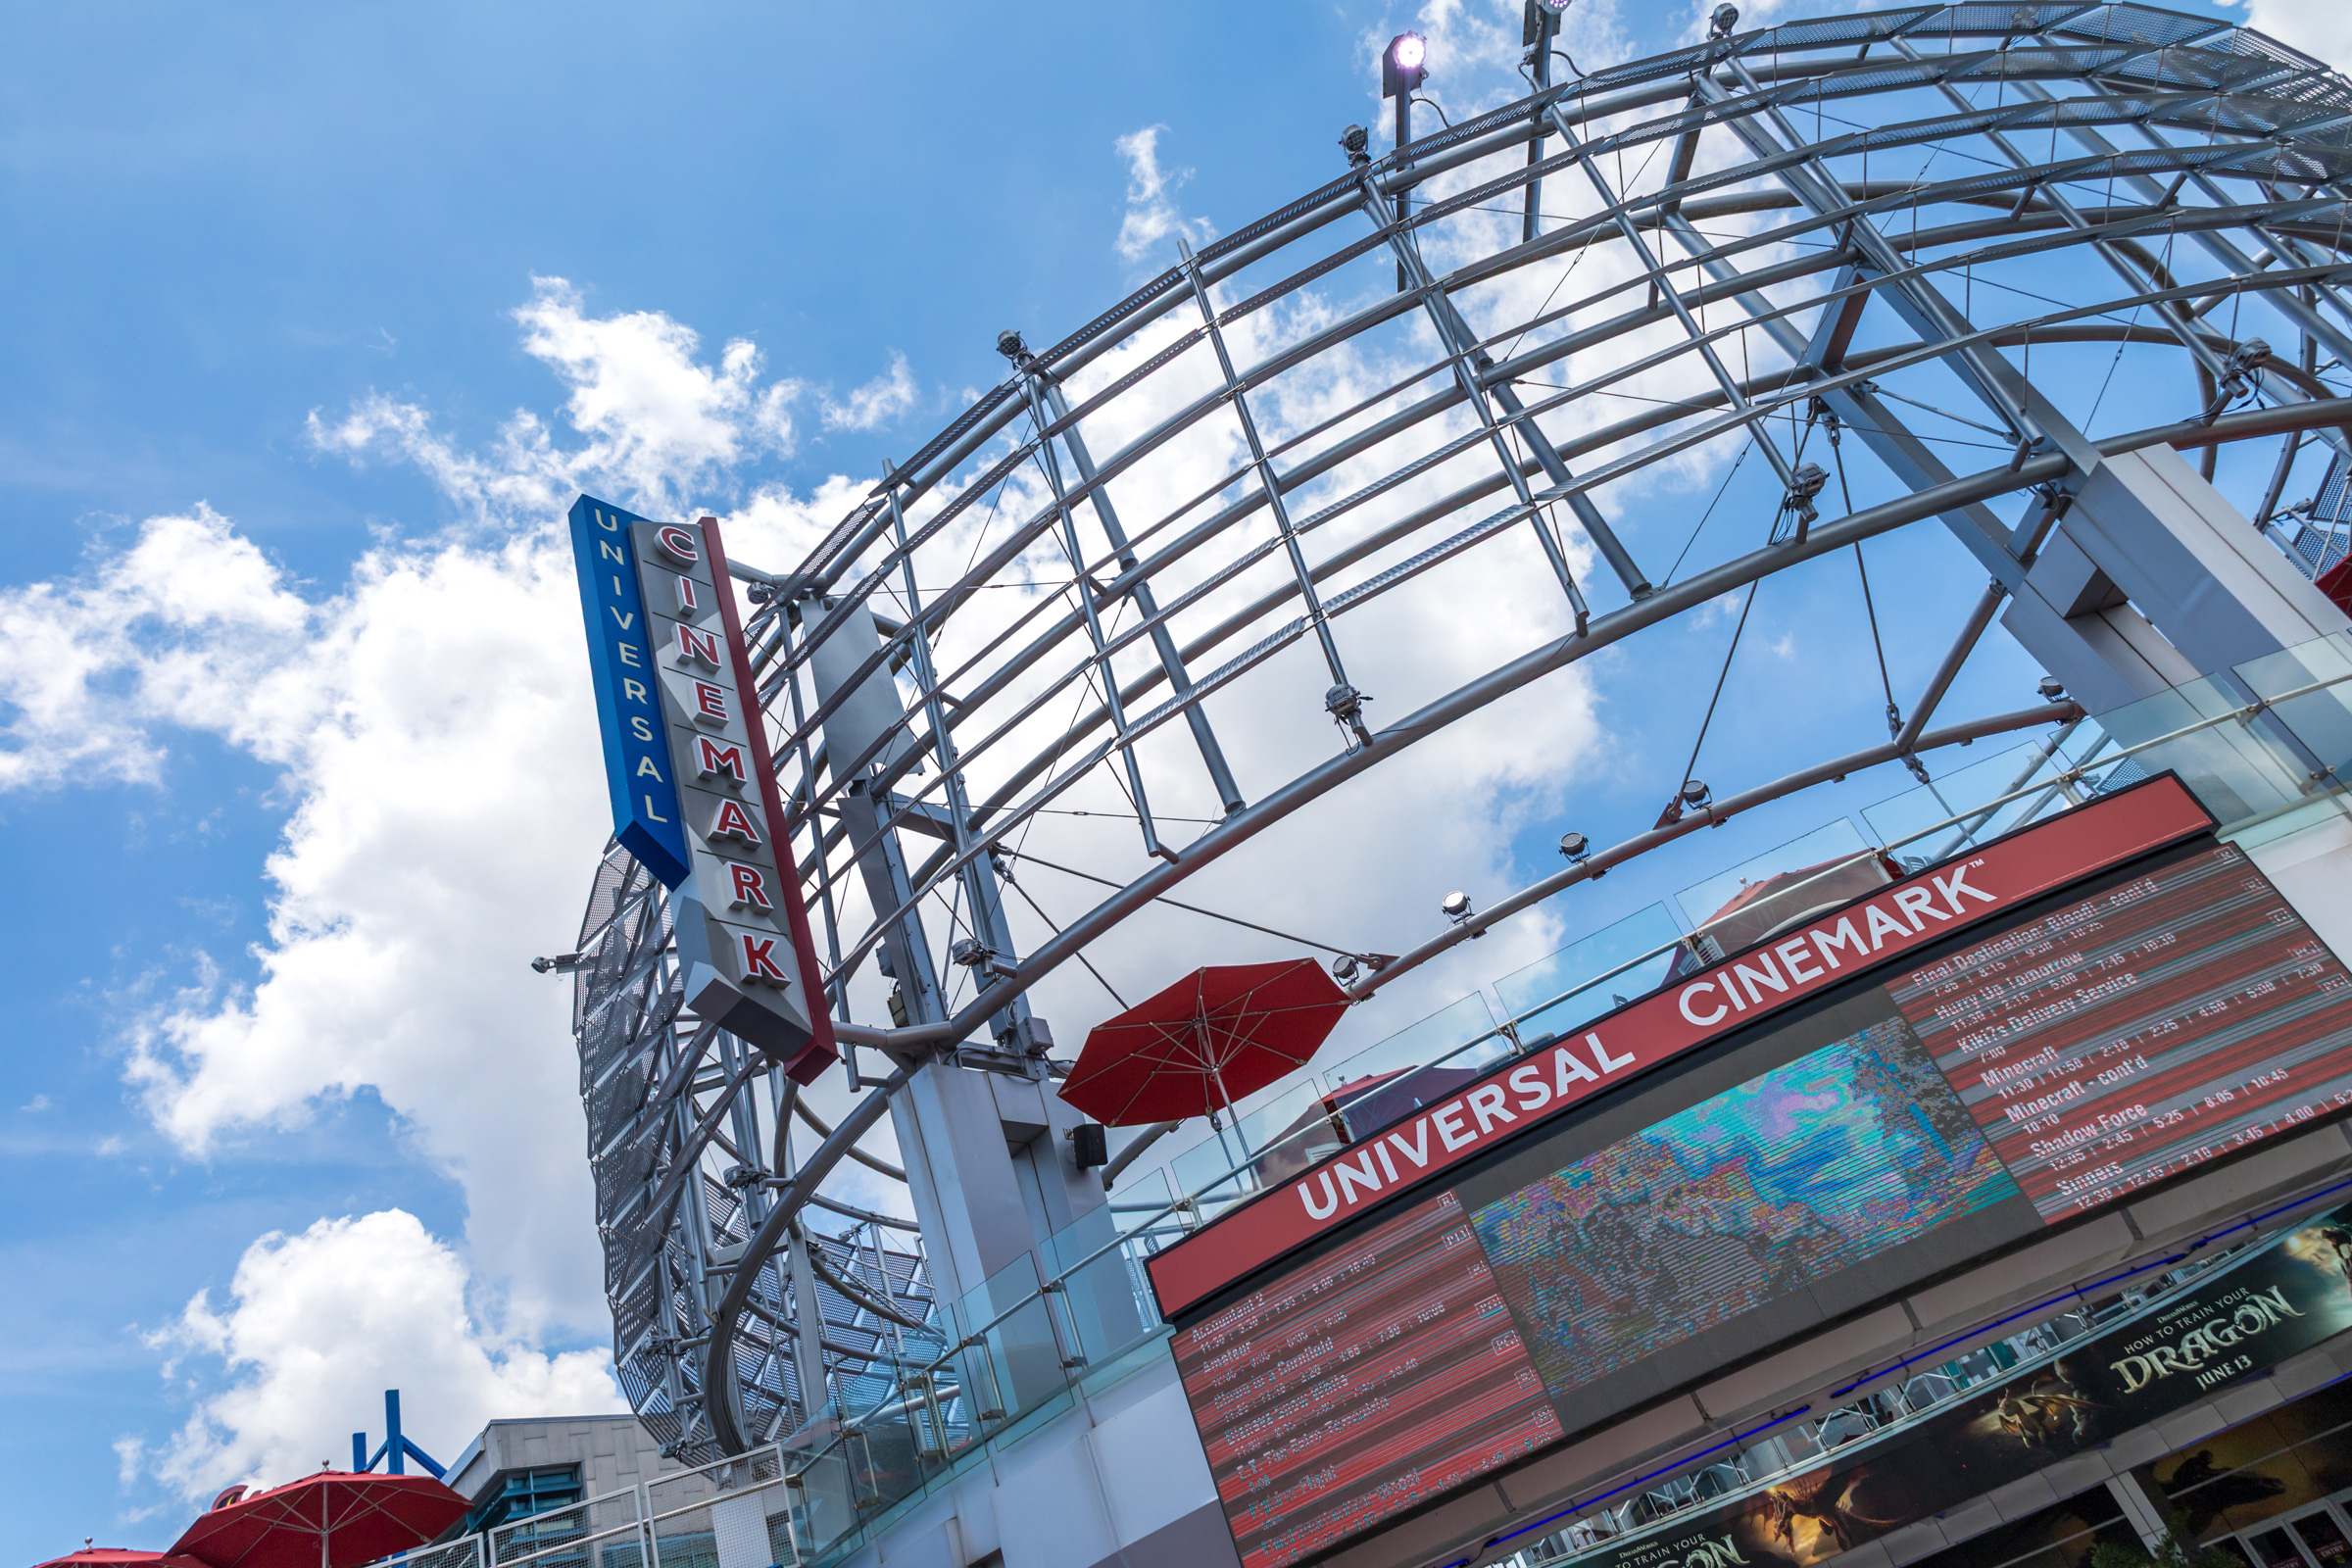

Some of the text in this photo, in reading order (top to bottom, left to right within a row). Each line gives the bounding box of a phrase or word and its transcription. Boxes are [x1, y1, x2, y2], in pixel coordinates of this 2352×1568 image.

[595, 507, 668, 823] UNIVERSAL
[655, 523, 790, 988] CINEMARK
[1911, 961, 1954, 989] Final
[1934, 993, 1980, 1020] Hurry
[2005, 951, 2084, 990] Tomorrow
[2007, 996, 2077, 1032] Delivery
[2075, 973, 2138, 1004] Service
[1998, 1077, 2034, 1100] 11:30
[2047, 1056, 2083, 1079] 11:50
[2293, 962, 2324, 979] 7:30
[1980, 1046, 2059, 1088] Minecraft
[2004, 1080, 2086, 1124] Minecraft
[2097, 1054, 2148, 1086] cont'd
[1297, 1032, 1636, 1220] UNIVERSAL
[2023, 1113, 2060, 1136] 10:10
[2030, 1102, 2148, 1159] Shadow Force
[2048, 1067, 2288, 1171] 12:05 2:45 5:25 8:05 10:45
[2056, 1161, 2124, 1197] Sinners
[2074, 1186, 2114, 1210] 12:30
[2127, 1165, 2165, 1188] 12:45
[2180, 1146, 2213, 1166] 2:10
[2231, 1125, 2264, 1146] 3:45
[2284, 1104, 2315, 1124] 4:00
[1255, 1292, 1265, 1307] 2
[2124, 1287, 2251, 1355] HOW TO TRAIN YOUR
[2109, 1285, 2306, 1395] DRAGON
[2195, 1354, 2253, 1392] JUNE 13
[1634, 1547, 1671, 1566] TRAIN
[1673, 1533, 1706, 1551] YOUR
[2320, 1544, 2344, 1557] ENTRY
